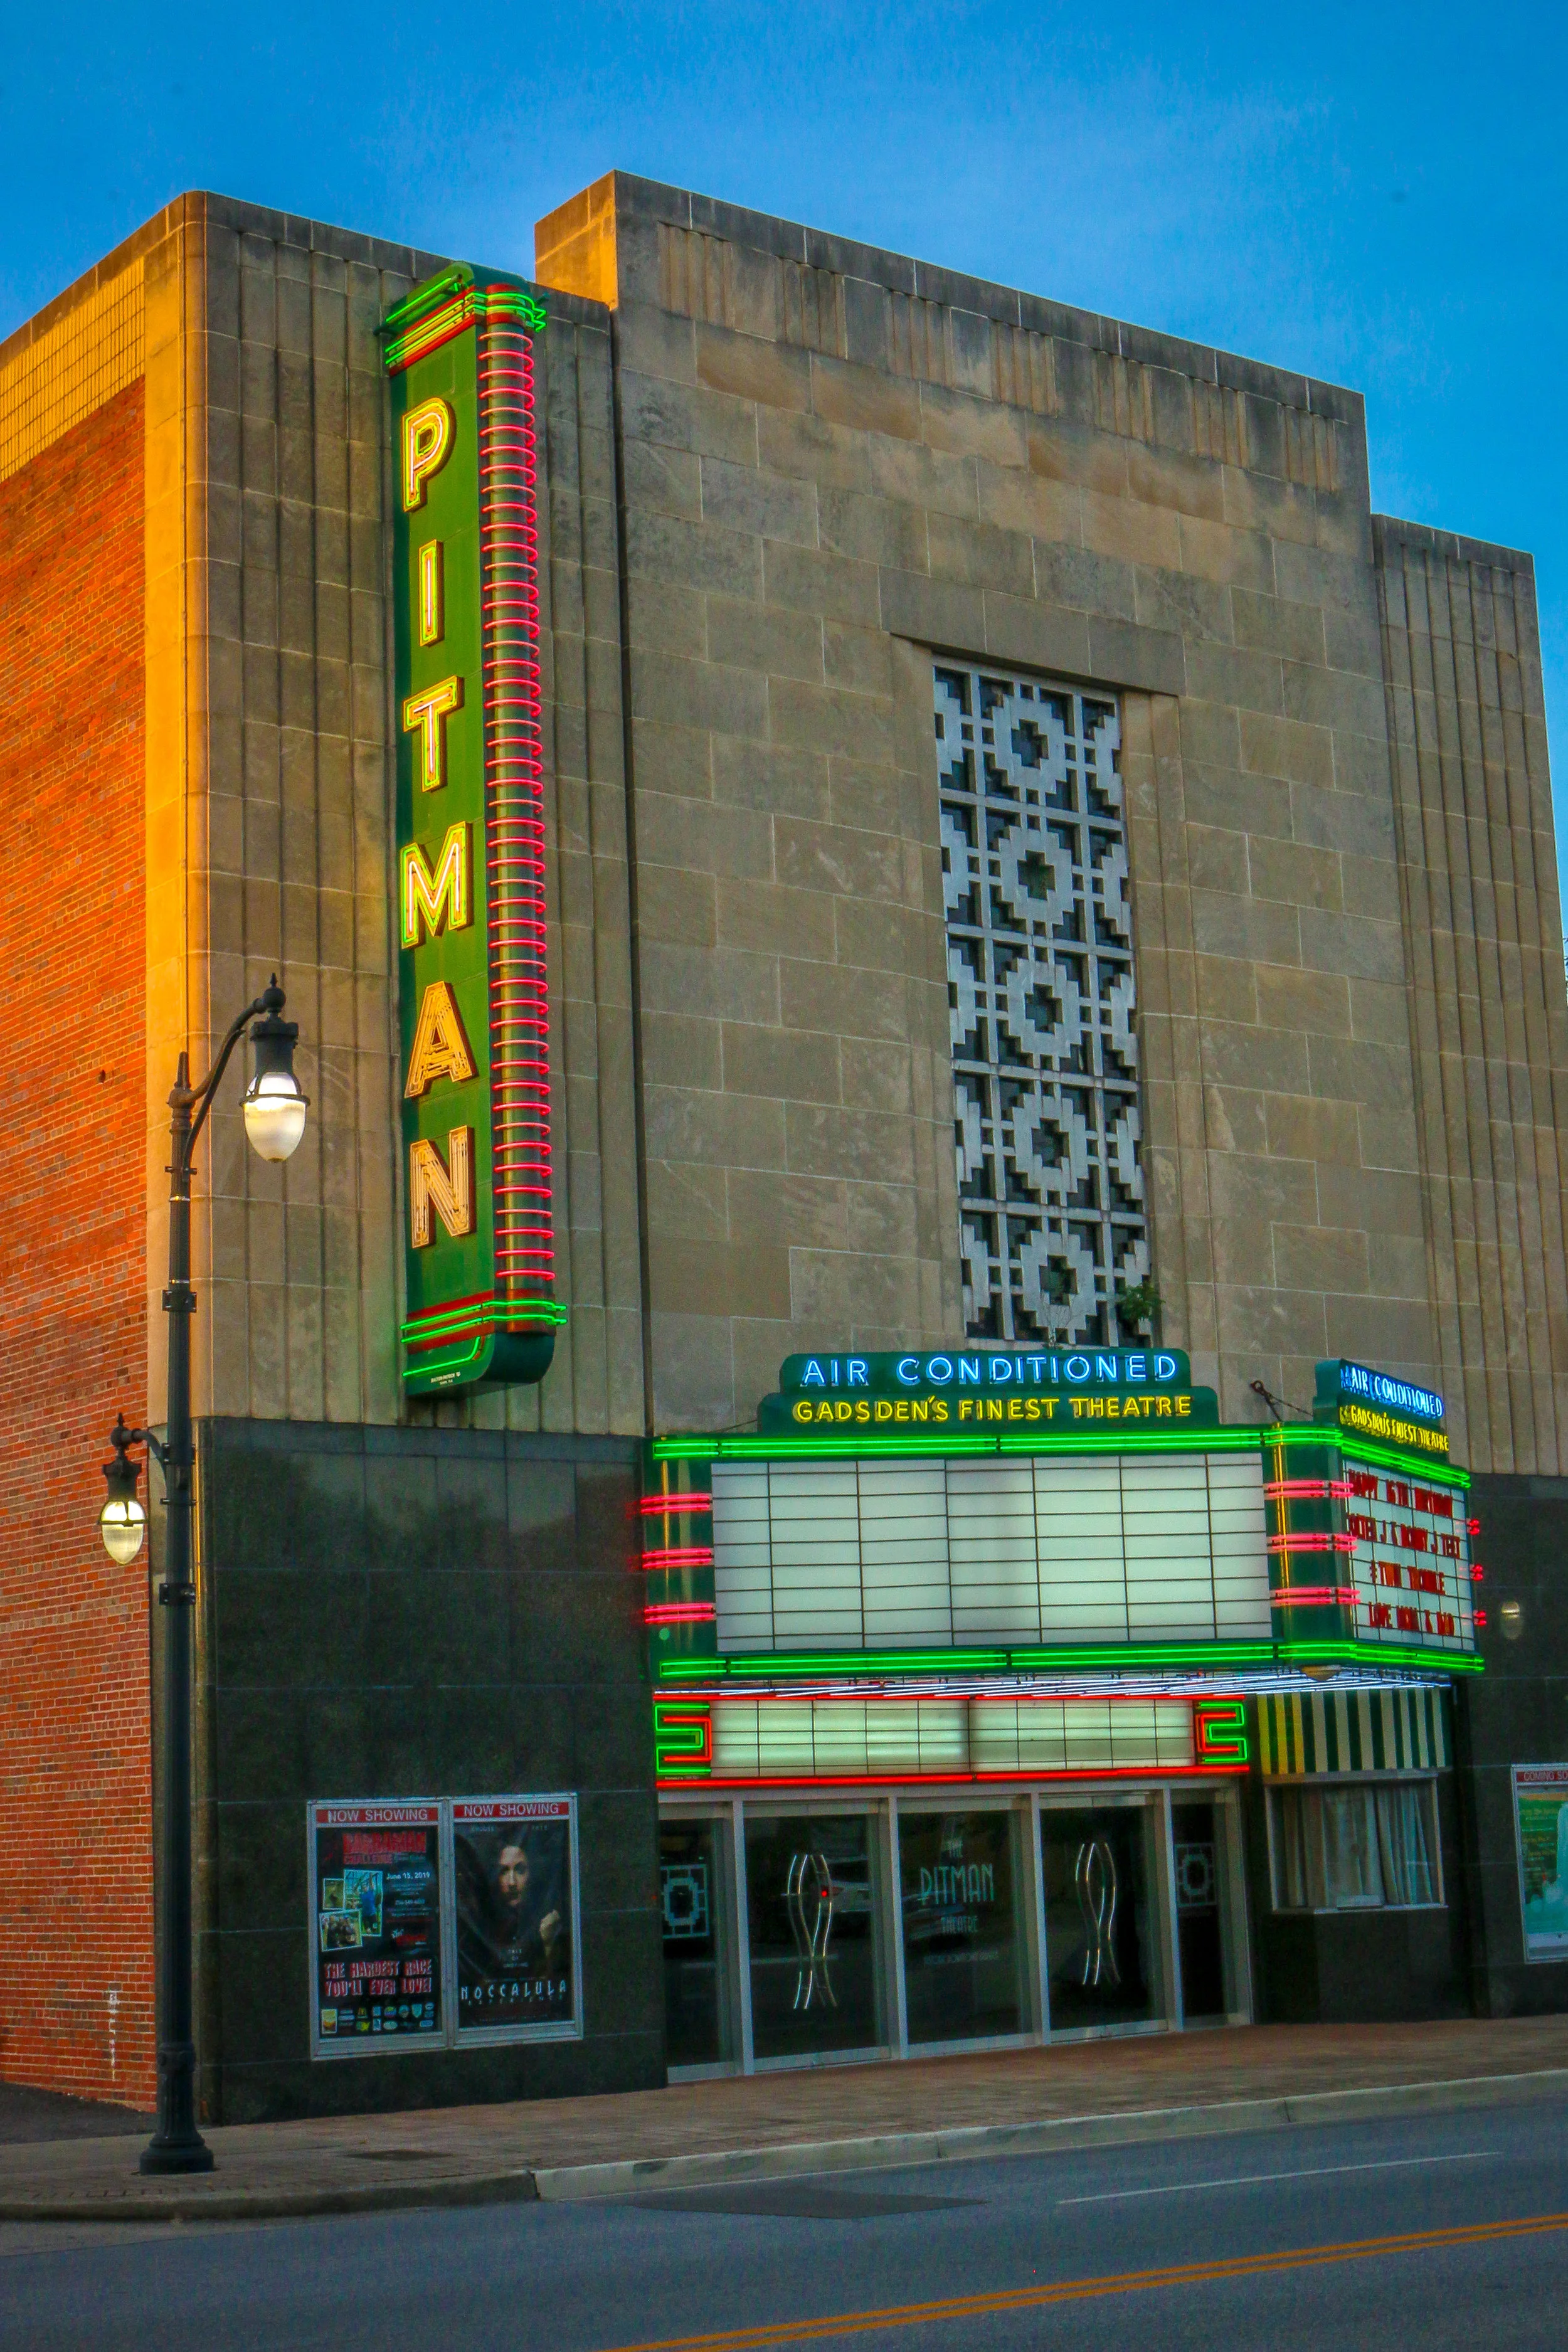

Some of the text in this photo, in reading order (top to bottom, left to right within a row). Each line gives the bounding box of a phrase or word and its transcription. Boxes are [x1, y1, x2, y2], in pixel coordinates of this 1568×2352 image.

[400, 396, 478, 1248] PITMAN
[800, 1354, 1177, 1387] AIR CONDITIONED
[1344, 1365, 1444, 1419] AIR CONDITIONED
[792, 1395, 1192, 1422] GADSDEN'S FINEST THEATRE
[1348, 1469, 1378, 1500] HAPPY
[1369, 1601, 1392, 1628] LOVE
[1523, 1771, 1554, 1781] COMING
[327, 1808, 428, 1823] NOW SHOWING
[464, 1802, 559, 1816] NOW SHOWING
[920, 1863, 995, 1905] PITMAN
[324, 1959, 432, 1979] THE HARDEST RACE
[368, 1979, 396, 1995] EVER
[460, 1979, 566, 2000] NOCCALULA
